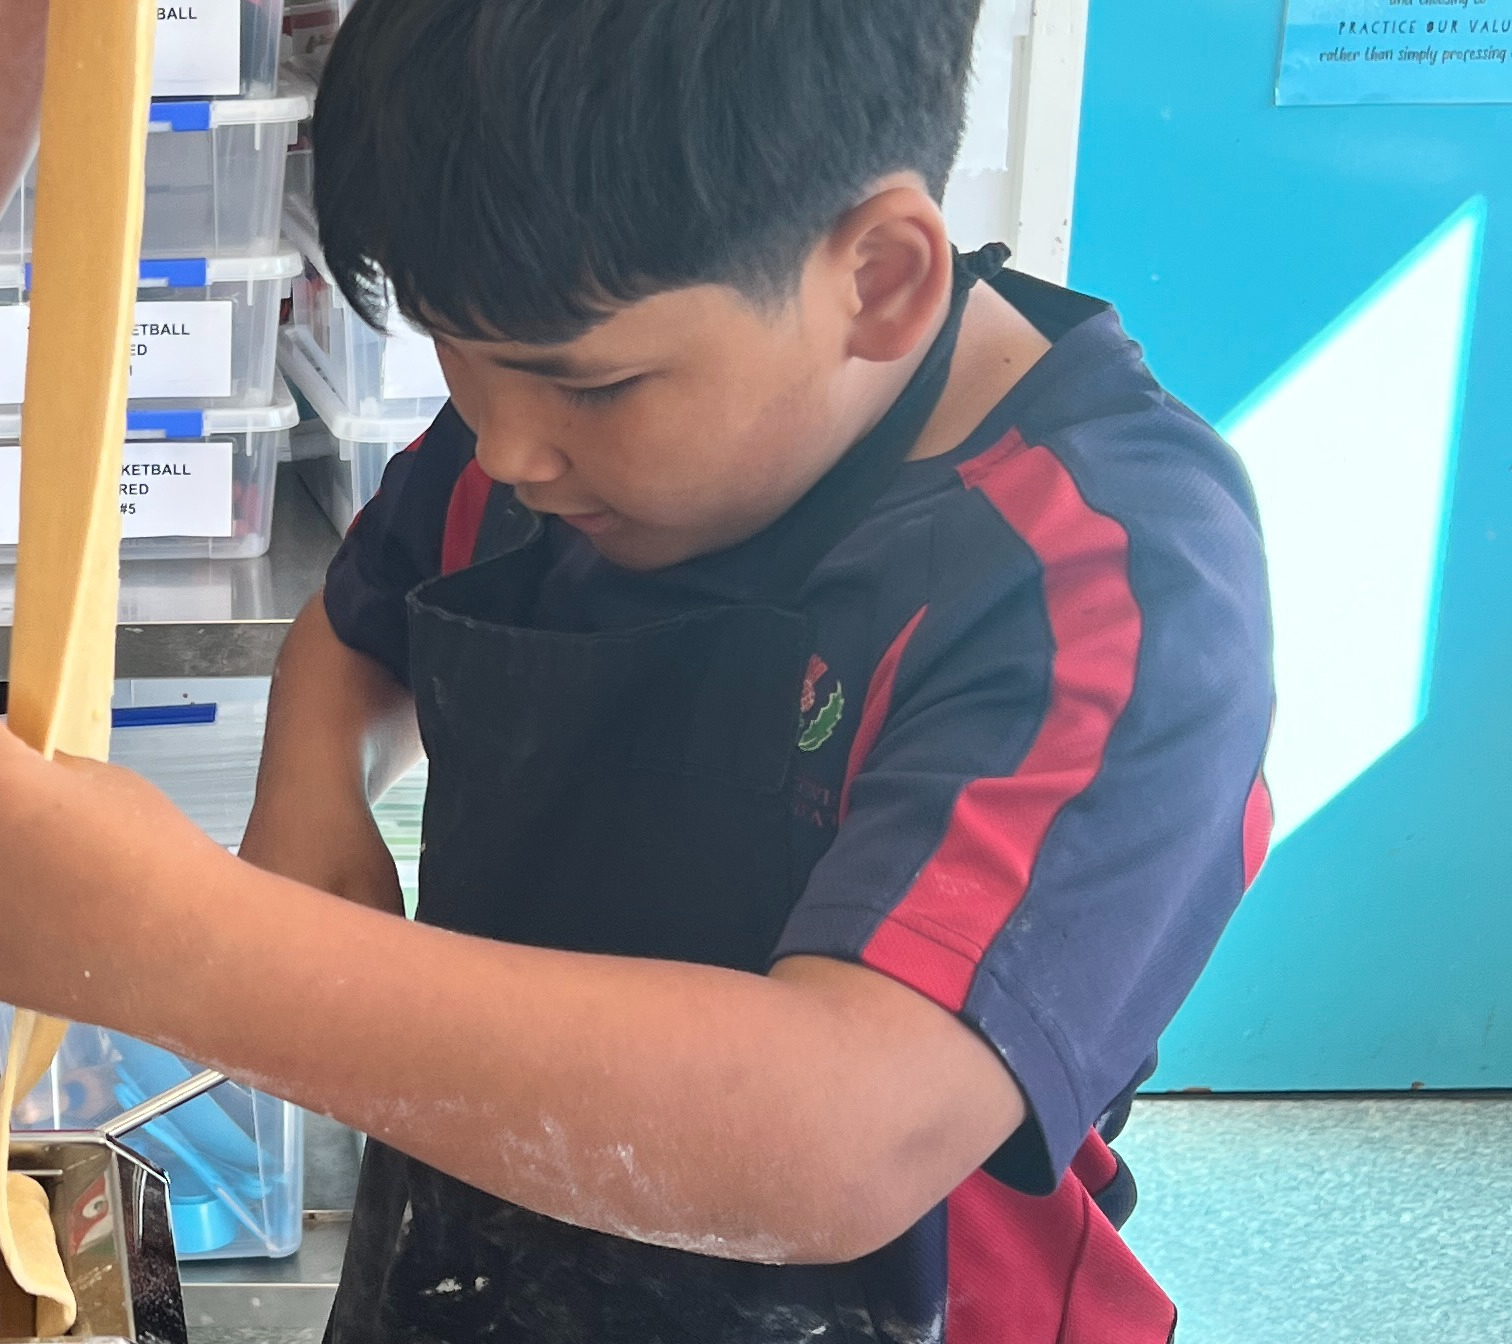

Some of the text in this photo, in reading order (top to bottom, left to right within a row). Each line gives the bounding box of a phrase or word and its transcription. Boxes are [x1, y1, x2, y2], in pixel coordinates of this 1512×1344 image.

[1338, 20, 1458, 35] PRACTICE OUR
[132, 324, 190, 336] ETBALL
[121, 464, 191, 475] KETBALL
[119, 484, 149, 495] RED
[120, 503, 136, 514] #5
